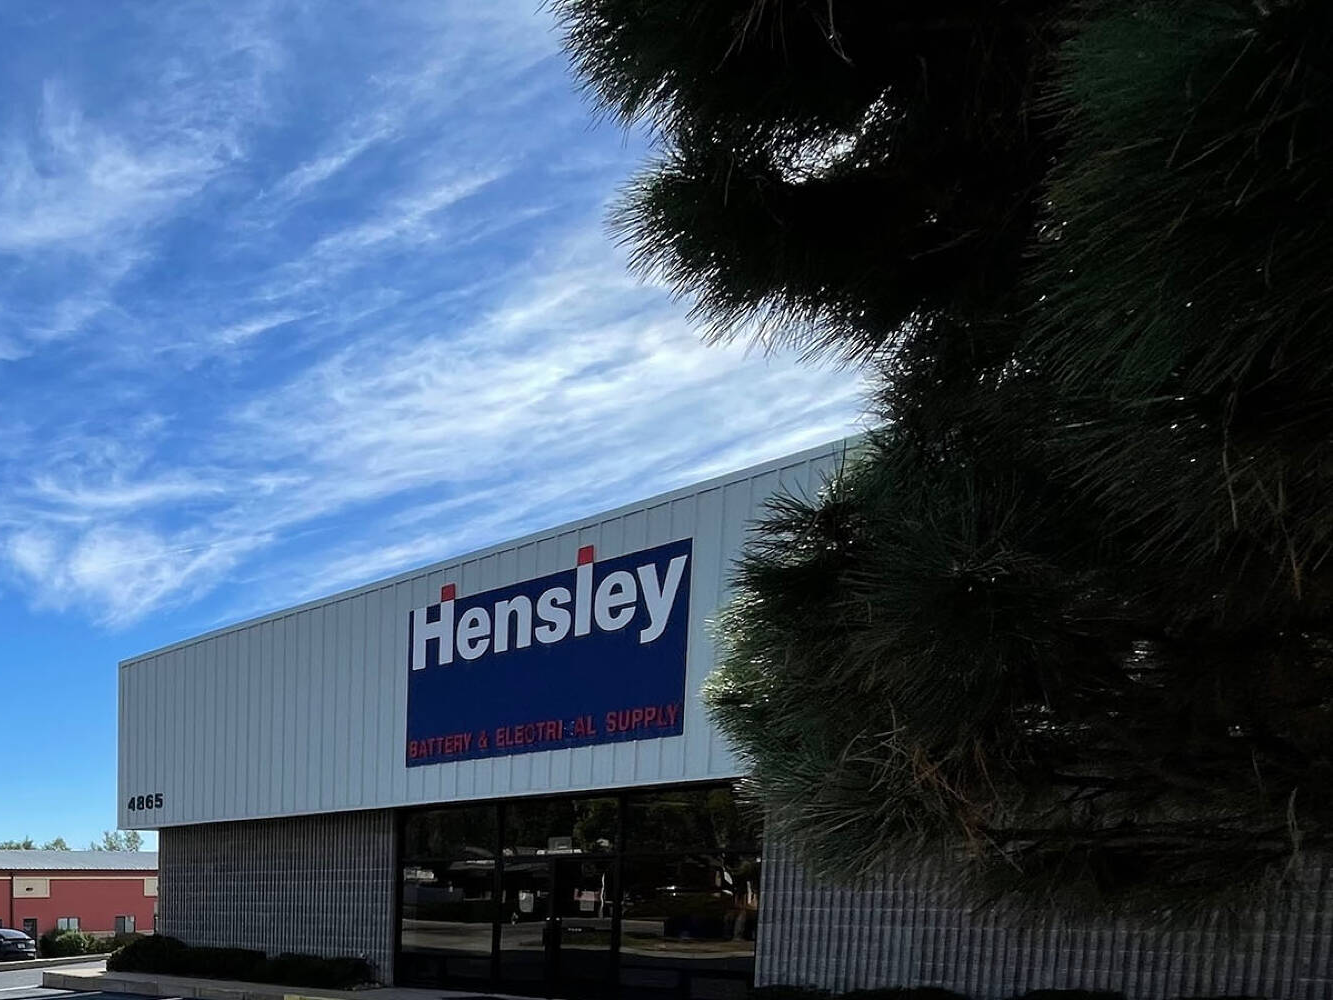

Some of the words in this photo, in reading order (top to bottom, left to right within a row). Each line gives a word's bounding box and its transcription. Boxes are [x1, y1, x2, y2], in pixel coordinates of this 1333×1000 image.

[411, 545, 688, 671] Hensley
[408, 730, 472, 758] BATTERY
[478, 732, 488, 750] &
[495, 716, 597, 747] ELECTRIAL
[606, 704, 679, 733] SUPPLY
[128, 793, 163, 811] 4865
